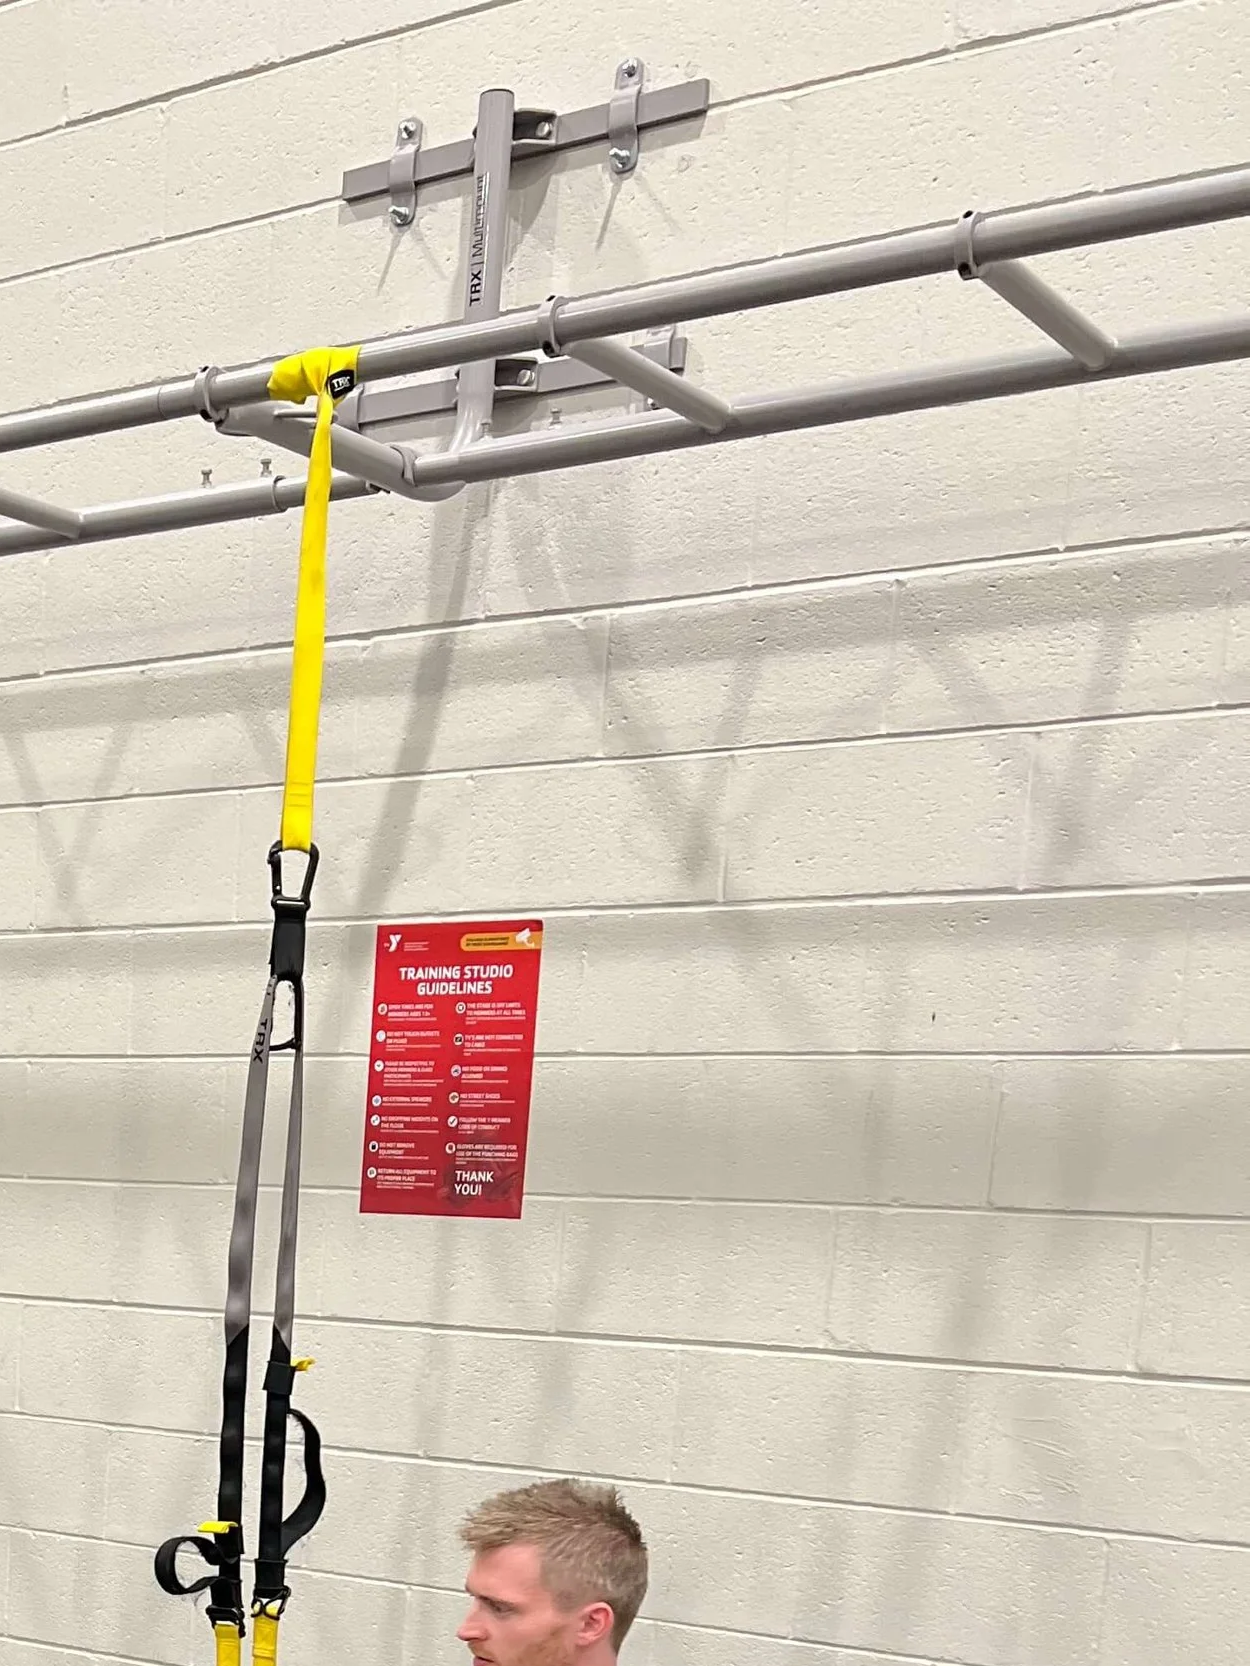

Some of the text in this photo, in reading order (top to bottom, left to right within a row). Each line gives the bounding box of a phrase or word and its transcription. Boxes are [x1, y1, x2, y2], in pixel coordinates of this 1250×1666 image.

[469, 270, 482, 307] TRX
[331, 376, 350, 389] TRX
[399, 965, 513, 980] TRAINING STUDIO
[417, 981, 493, 995] GUIDELINES
[253, 1018, 268, 1065] TRX
[455, 1171, 494, 1183] THANK
[454, 1184, 482, 1195] YOU!
